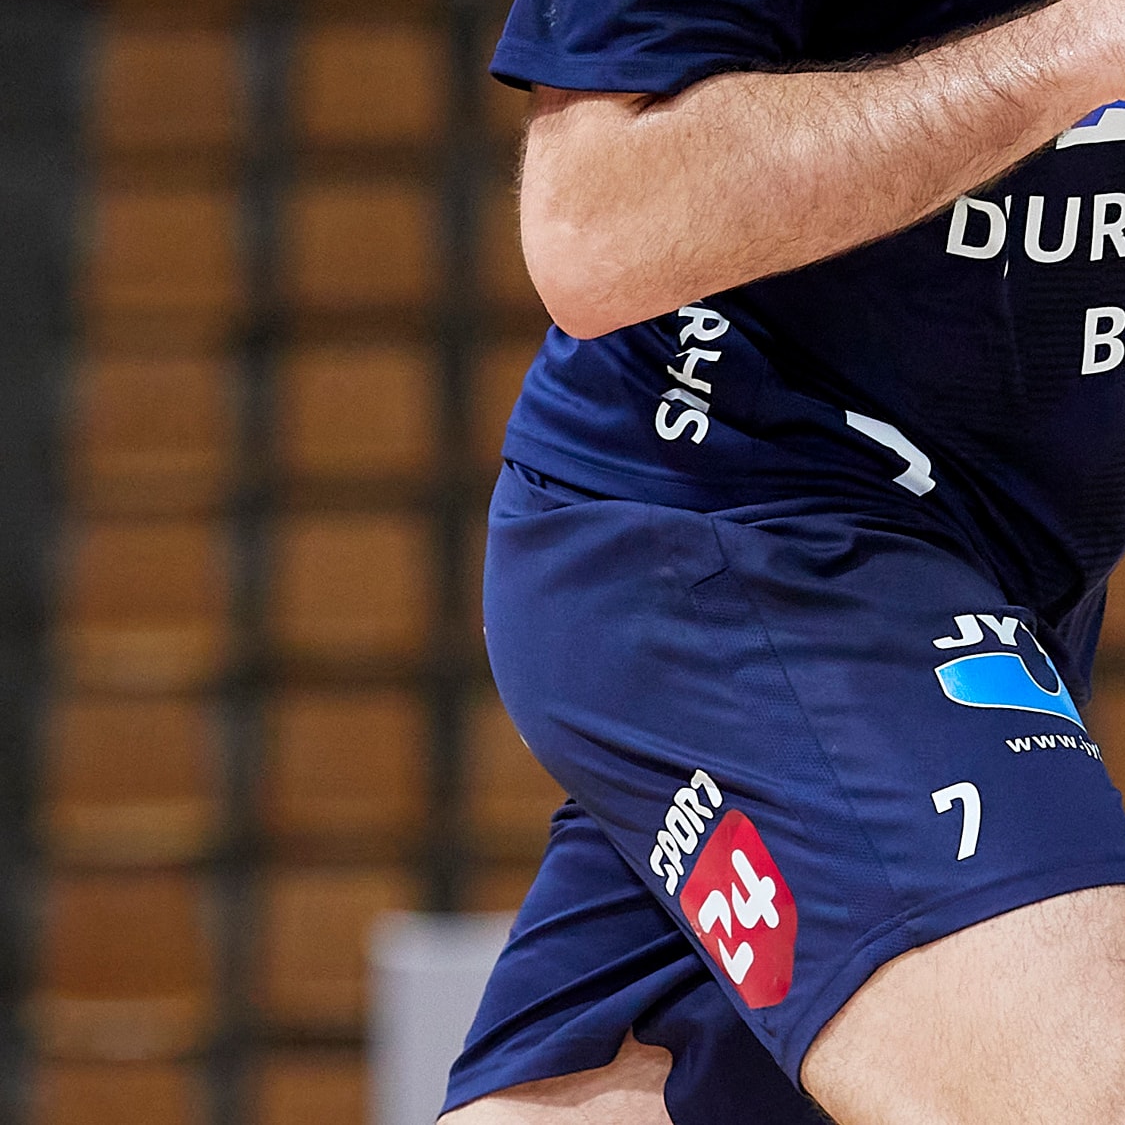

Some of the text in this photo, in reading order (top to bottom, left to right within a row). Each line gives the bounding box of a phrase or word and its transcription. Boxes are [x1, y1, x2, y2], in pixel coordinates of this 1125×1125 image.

[932, 614, 1048, 656] JY
[1005, 734, 1103, 762] www.jy
[650, 769, 723, 896] SPORT
[932, 782, 982, 861] 7
[698, 849, 780, 985] 24
